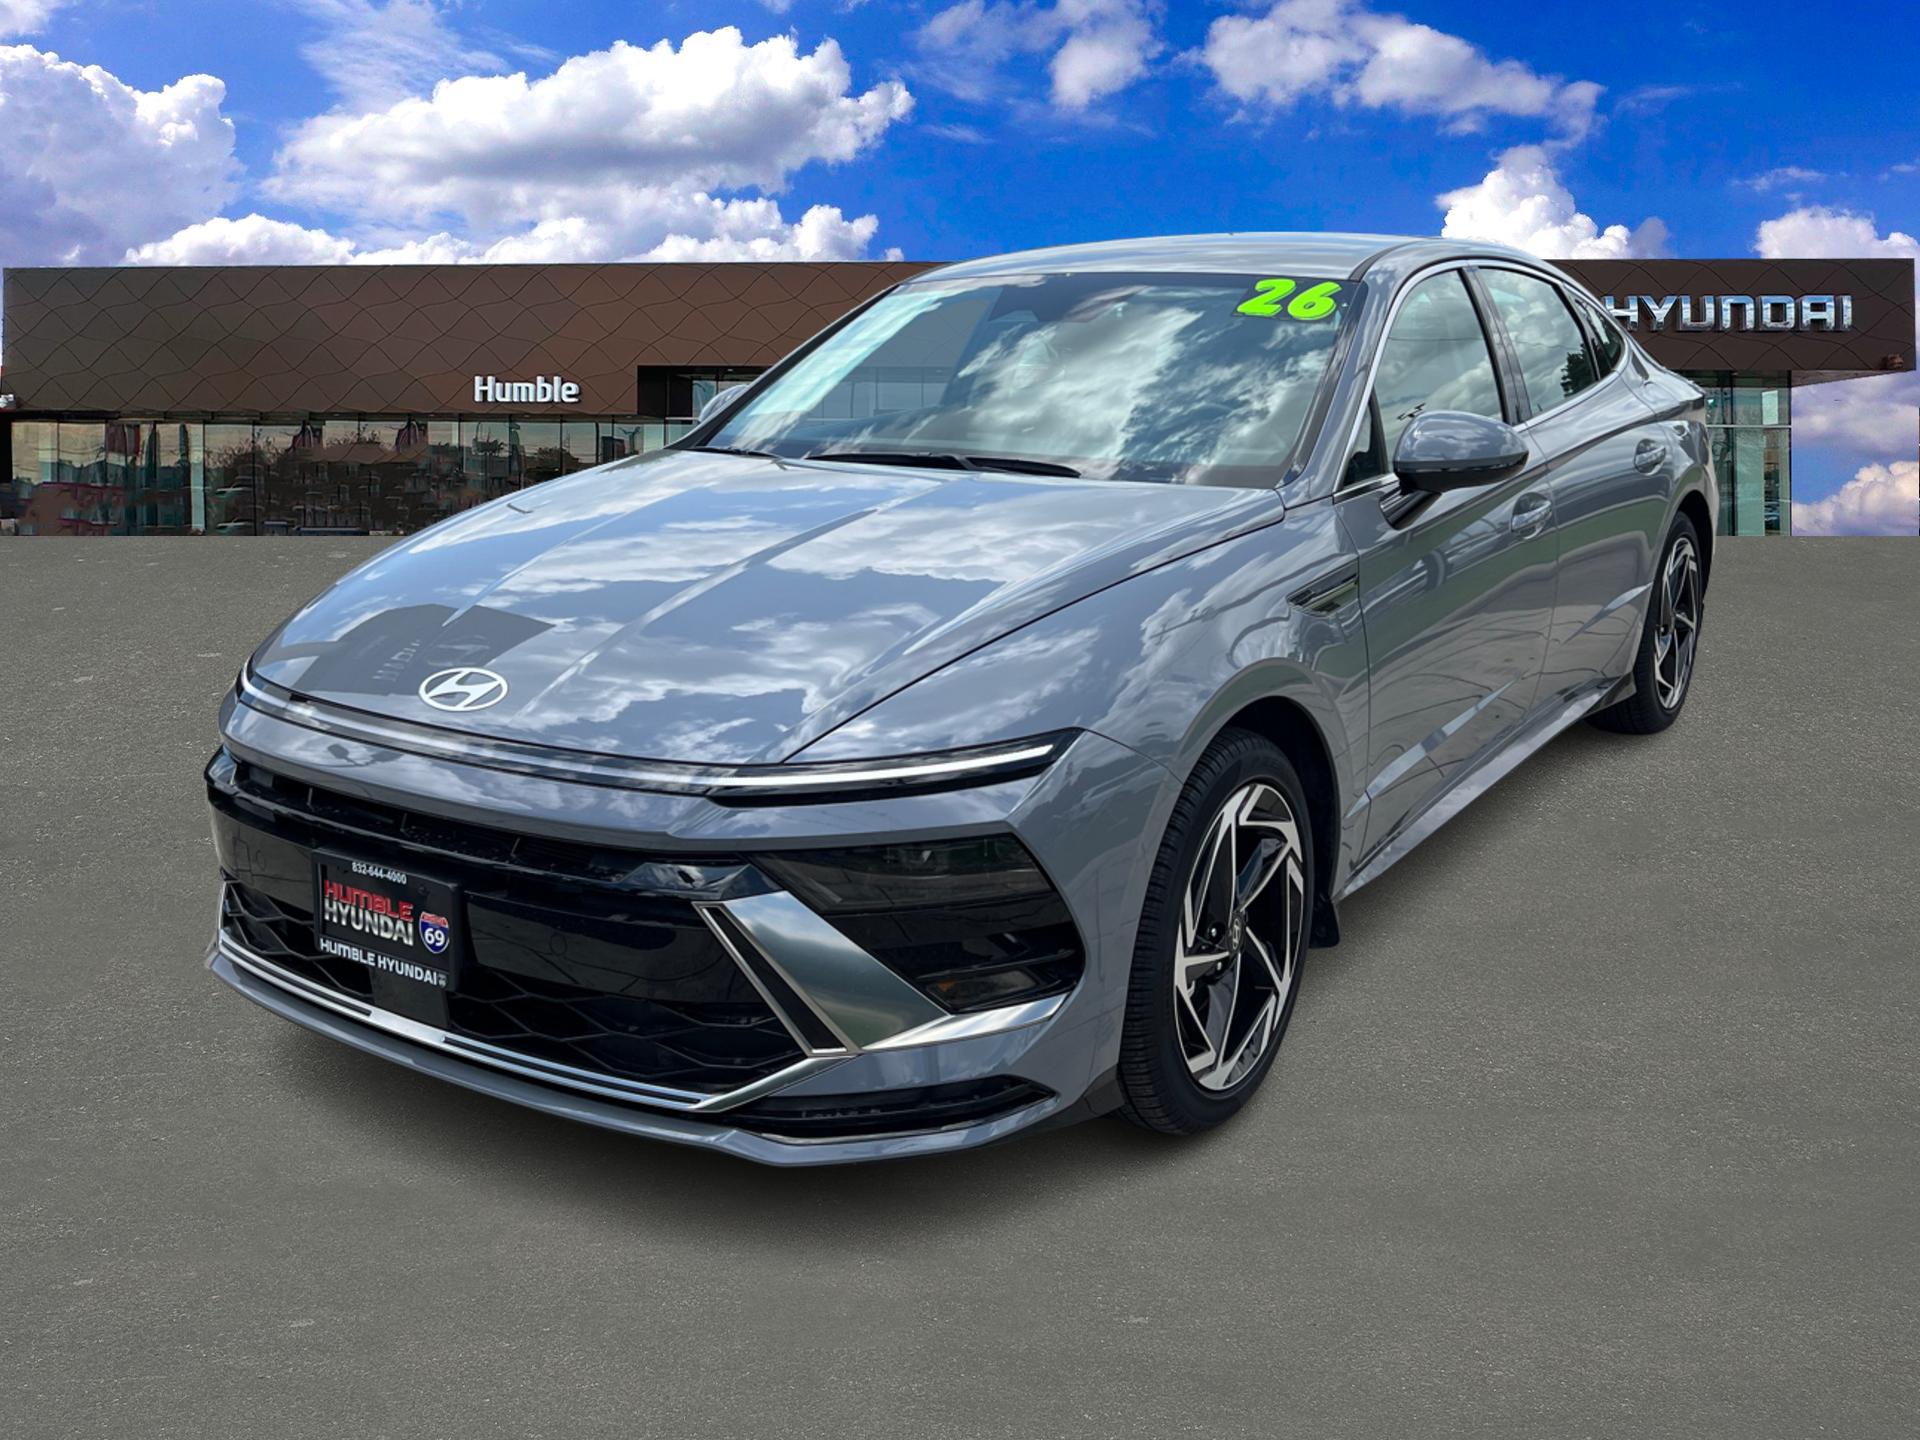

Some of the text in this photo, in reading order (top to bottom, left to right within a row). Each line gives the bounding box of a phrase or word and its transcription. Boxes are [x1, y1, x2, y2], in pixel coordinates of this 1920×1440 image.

[1236, 278, 1342, 321] 26
[1602, 295, 1852, 331] HYUNDAI
[474, 375, 580, 402] Humble
[323, 898, 414, 946] HYUNDAI
[424, 927, 445, 946] 69
[377, 955, 438, 986] HYUNDAI
